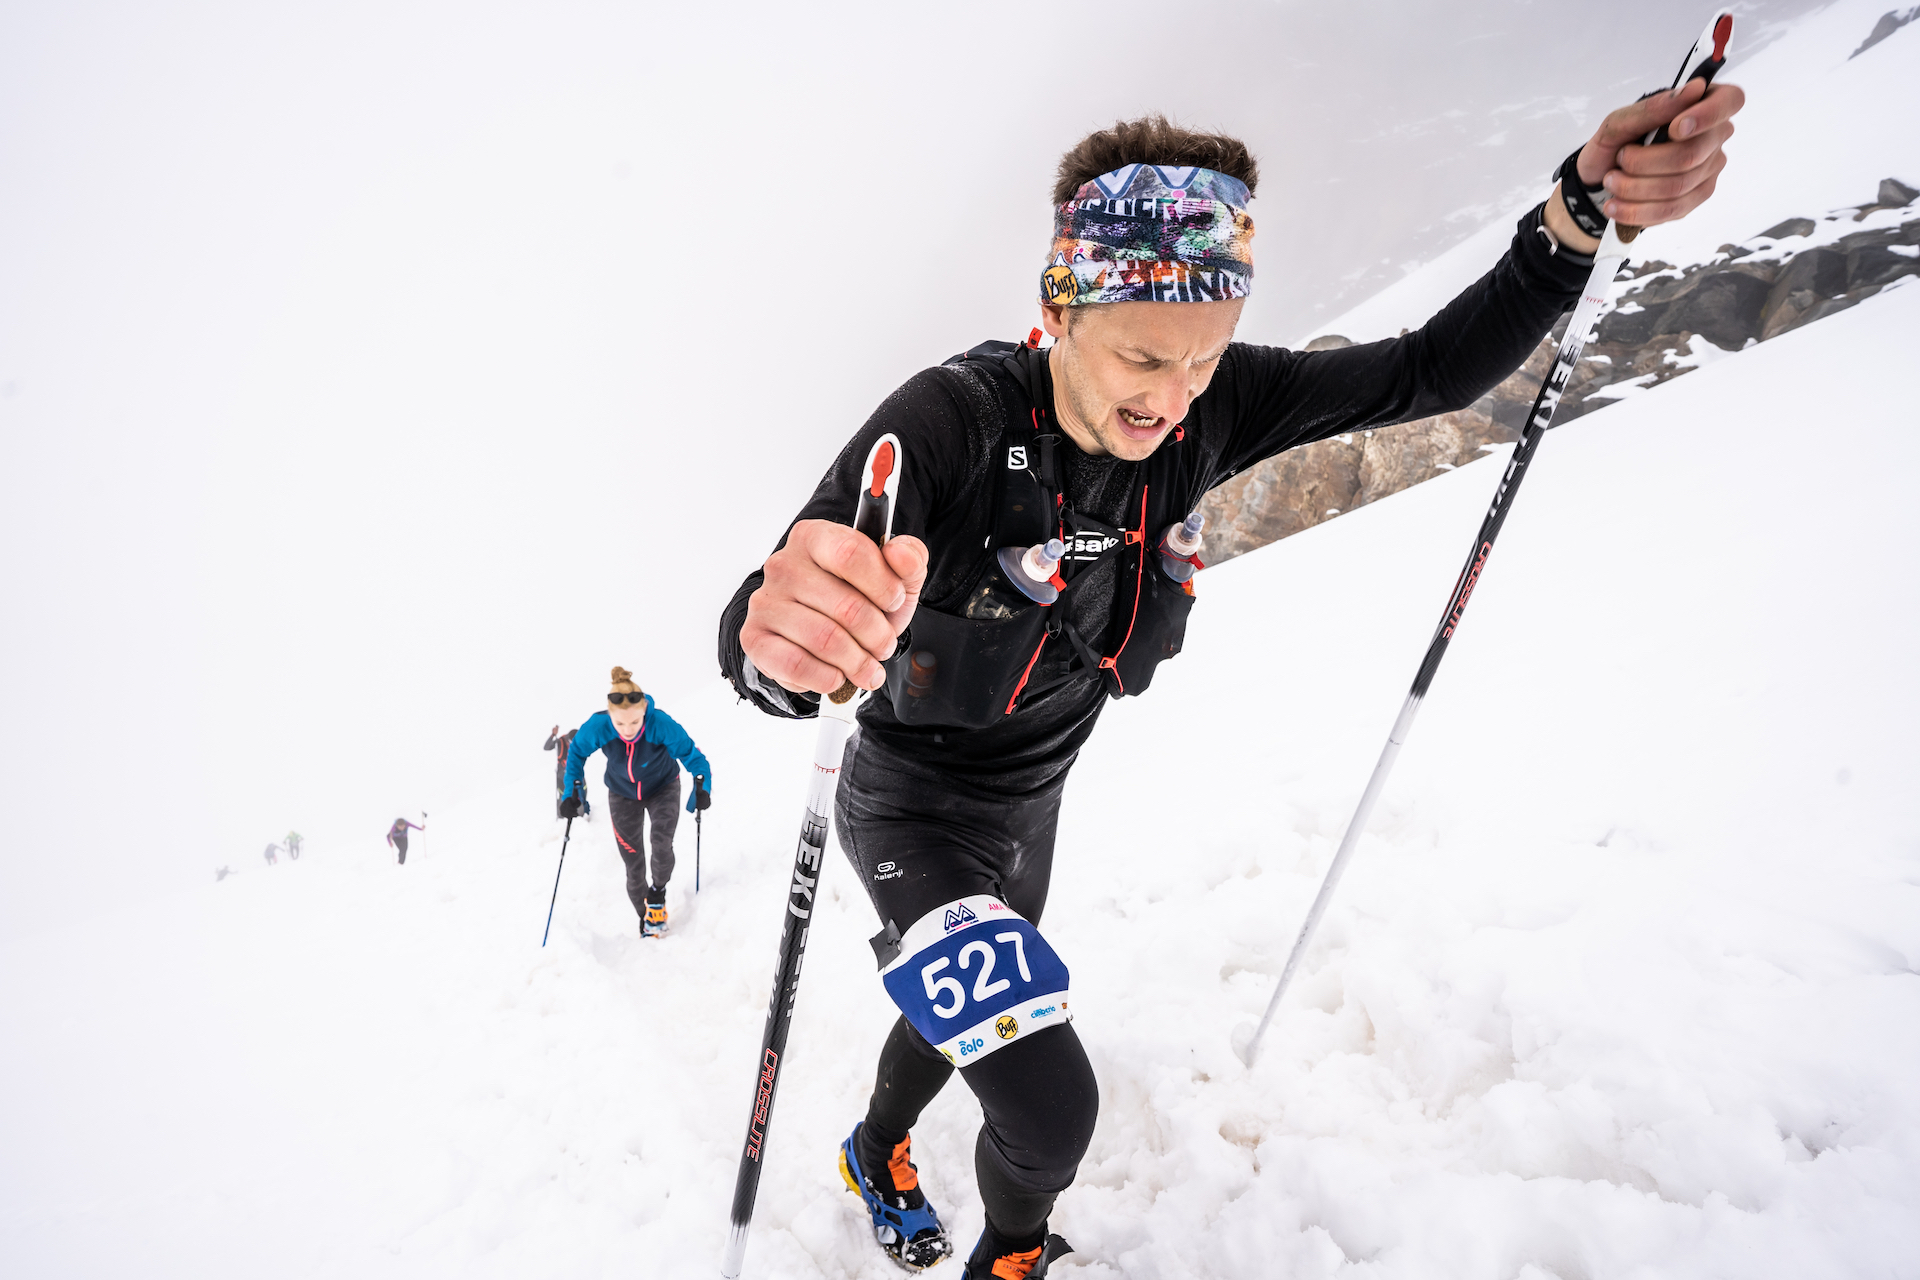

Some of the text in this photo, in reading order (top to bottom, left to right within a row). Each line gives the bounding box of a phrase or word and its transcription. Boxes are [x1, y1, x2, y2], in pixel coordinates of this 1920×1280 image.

[1442, 540, 1492, 642] CROSSLITE
[788, 806, 828, 920] LEKI
[873, 868, 904, 881] Kalenji
[921, 931, 1032, 1019] 527
[746, 1047, 779, 1162] CROSSLITE
